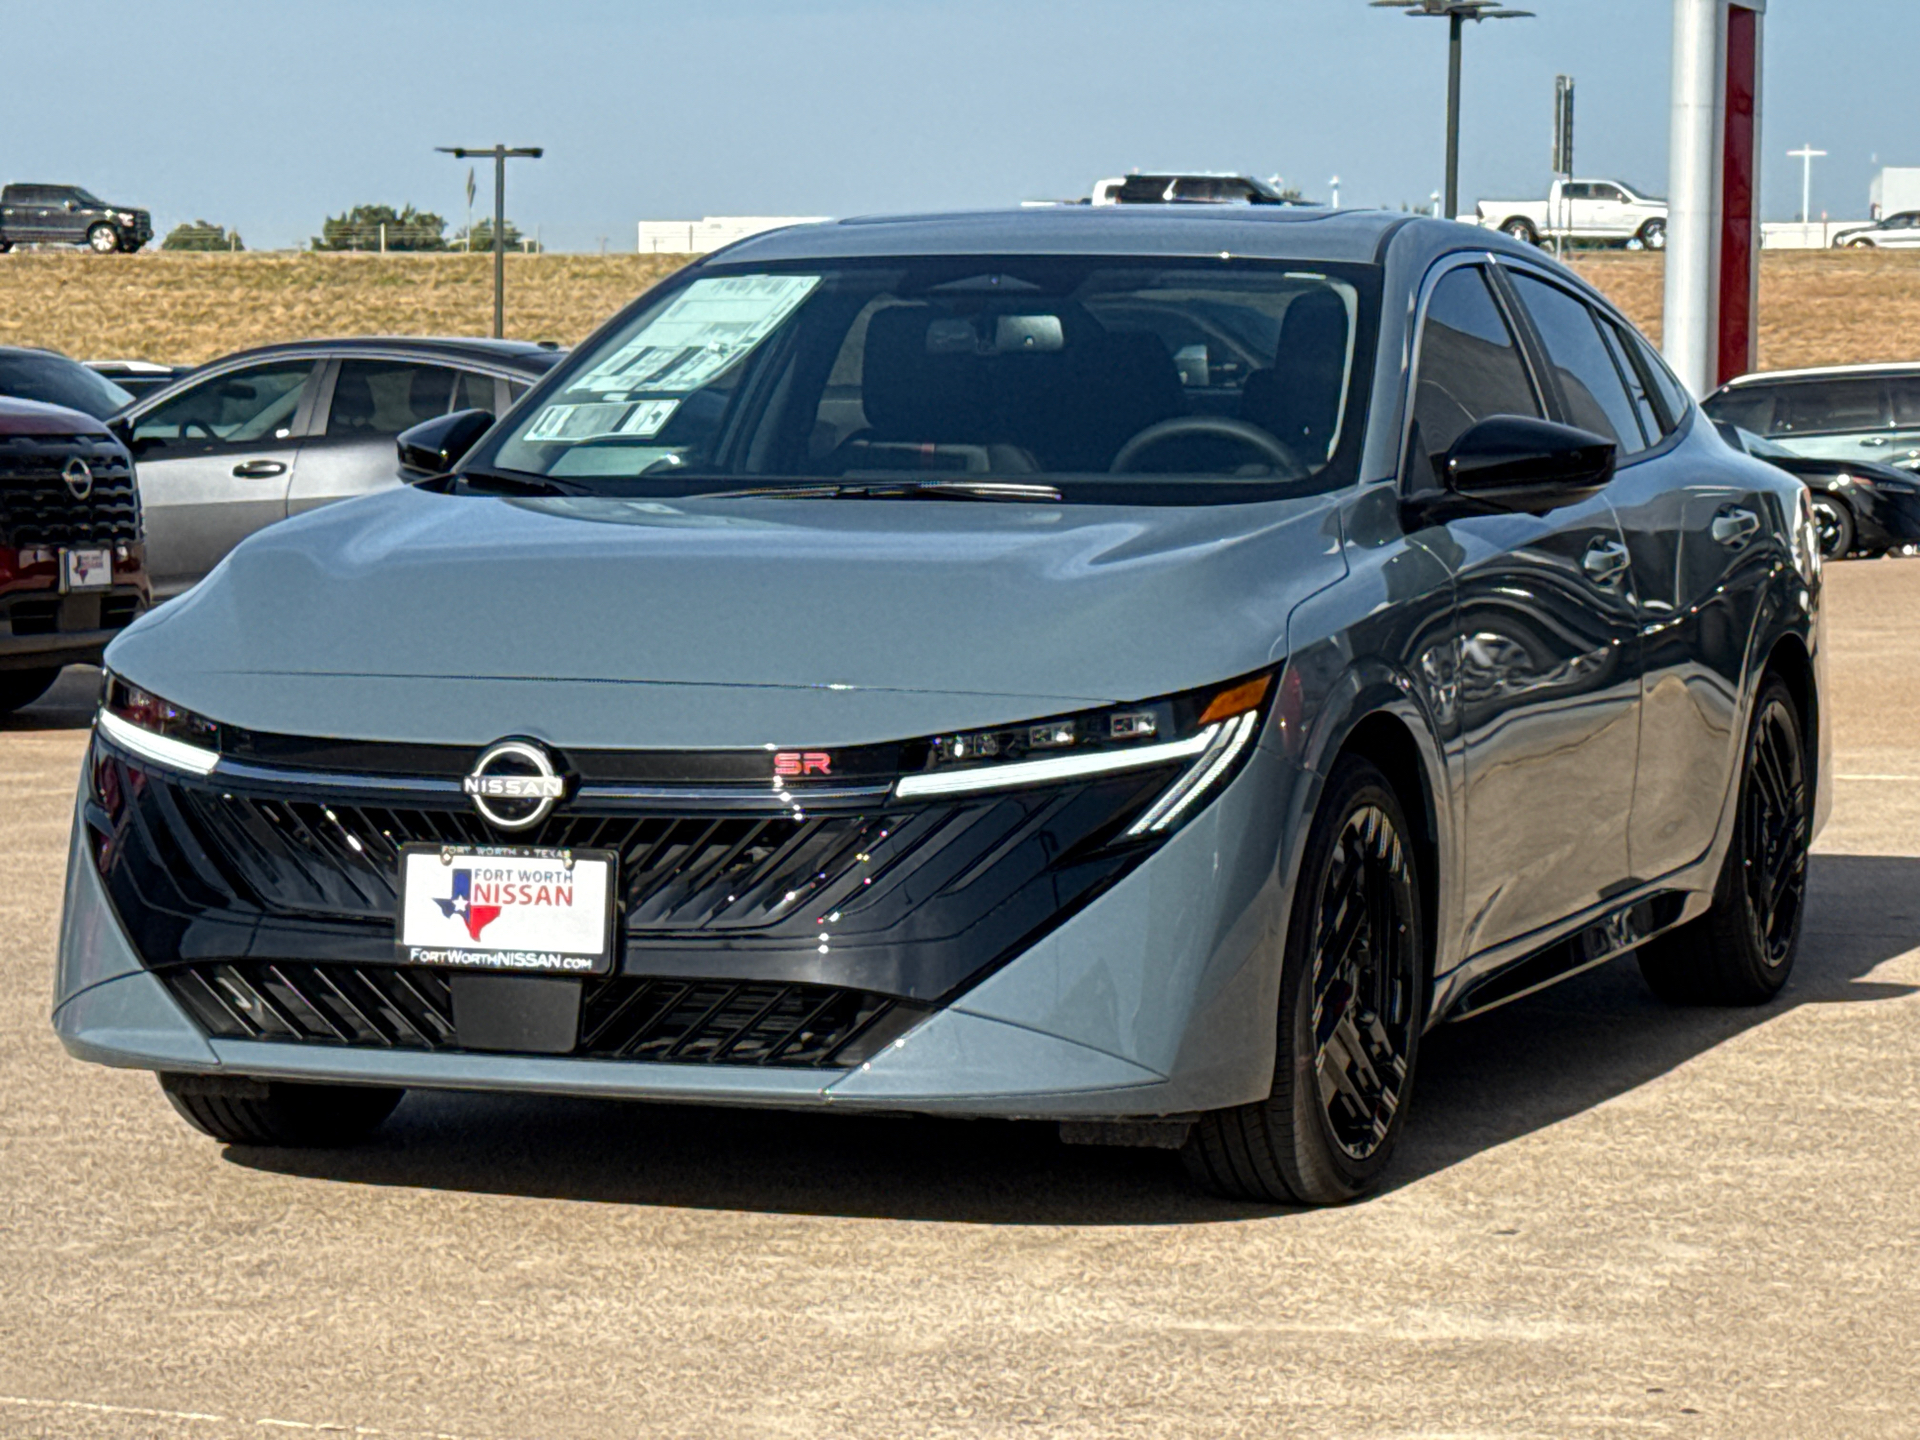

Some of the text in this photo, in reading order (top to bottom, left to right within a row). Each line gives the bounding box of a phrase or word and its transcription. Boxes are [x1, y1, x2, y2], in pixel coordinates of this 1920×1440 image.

[774, 752, 832, 775] SR
[464, 777, 563, 797] NISSAN
[441, 845, 572, 859] FORT WORTH TEXAS
[474, 868, 574, 884] FORT WORTH
[474, 883, 574, 907] NISSAN
